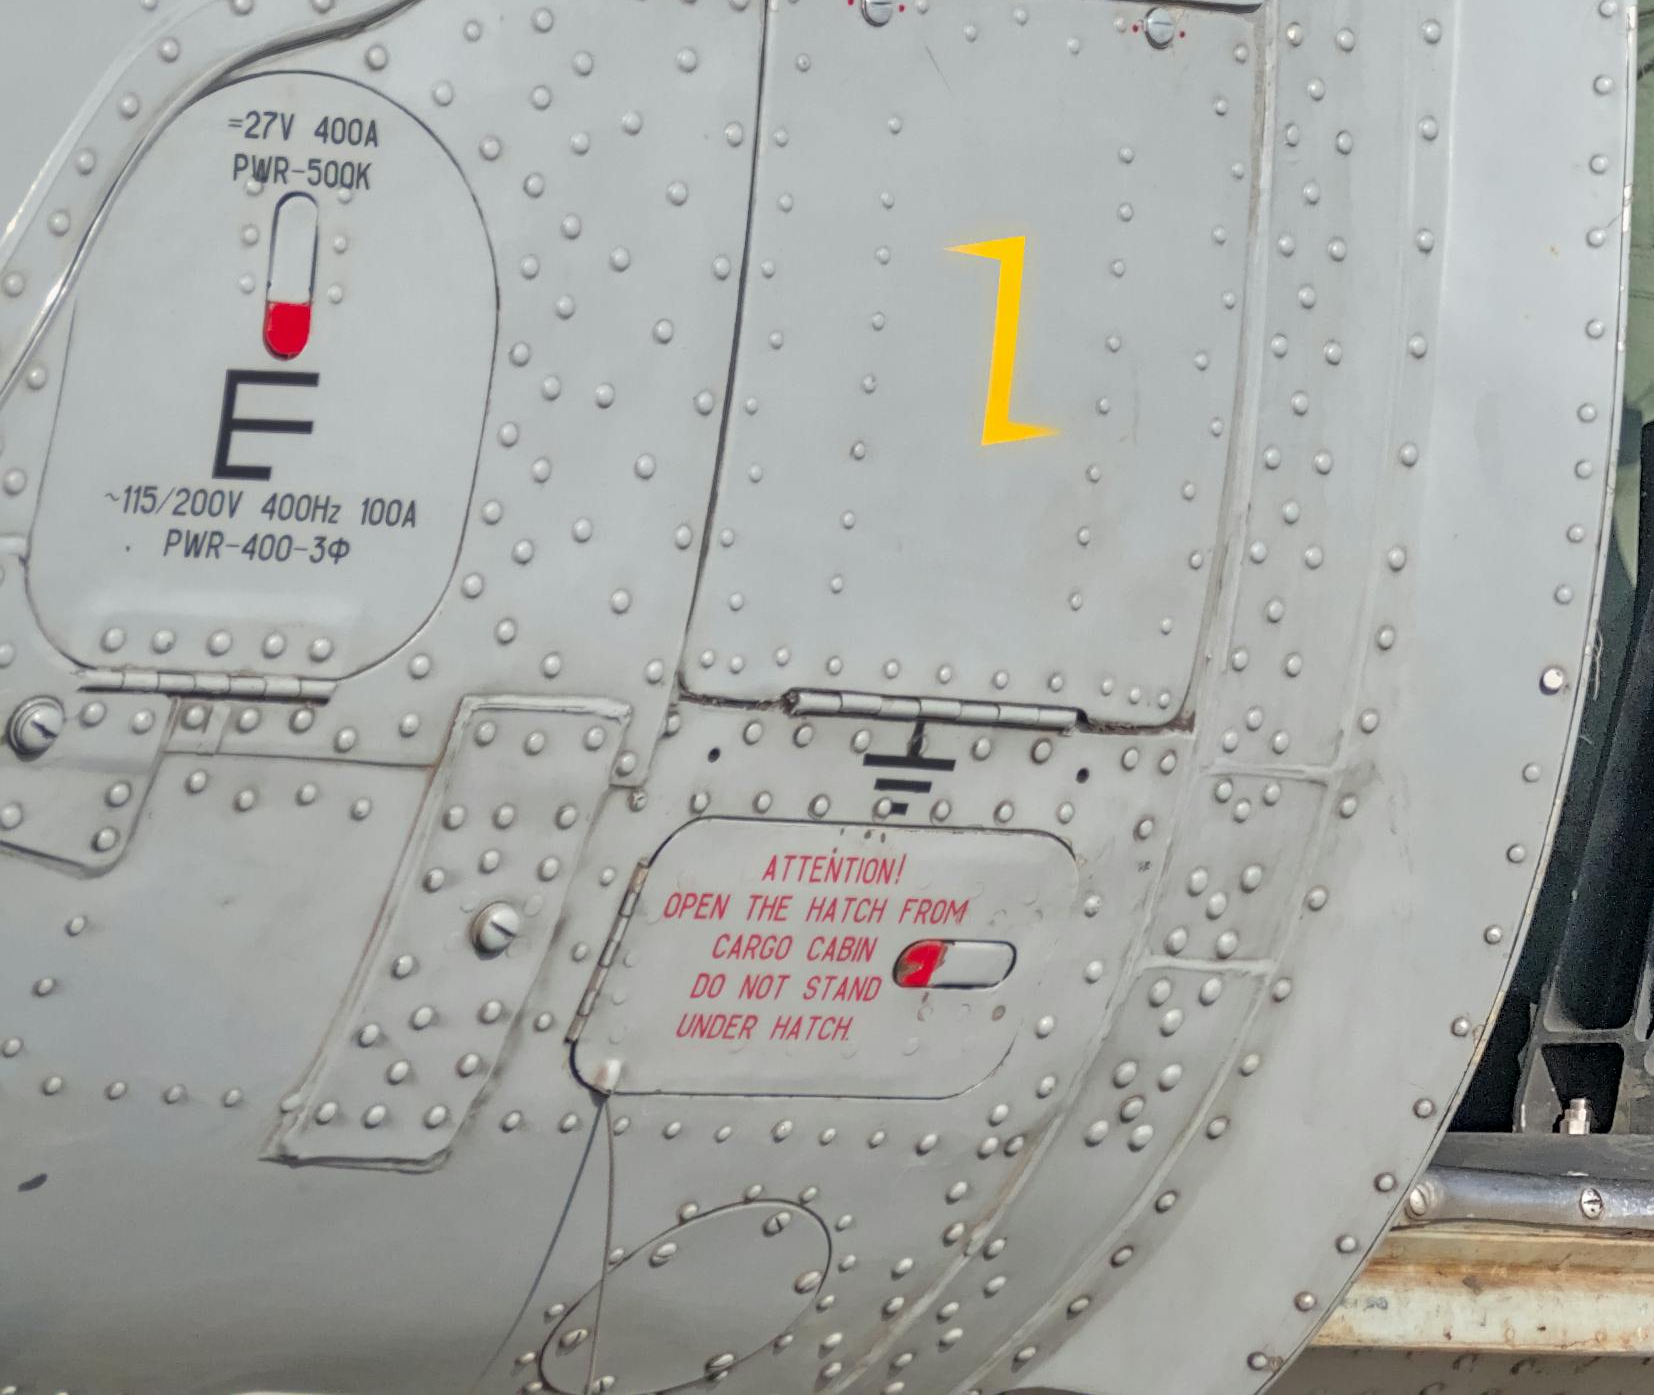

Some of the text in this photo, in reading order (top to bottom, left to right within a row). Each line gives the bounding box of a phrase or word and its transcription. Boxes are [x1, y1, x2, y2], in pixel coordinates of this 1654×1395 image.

[314, 116, 379, 148] 400A
[233, 153, 372, 191] PWR-500K
[261, 492, 341, 524] 400Hz
[361, 497, 417, 528] 100A
[761, 853, 907, 886] ATTENTION!
[662, 891, 969, 925] OPEN THE HATCH FROM
[711, 932, 877, 963] CARGO CABIN
[690, 972, 883, 1003] DO NOT STAND
[675, 1013, 759, 1041] UNDER
